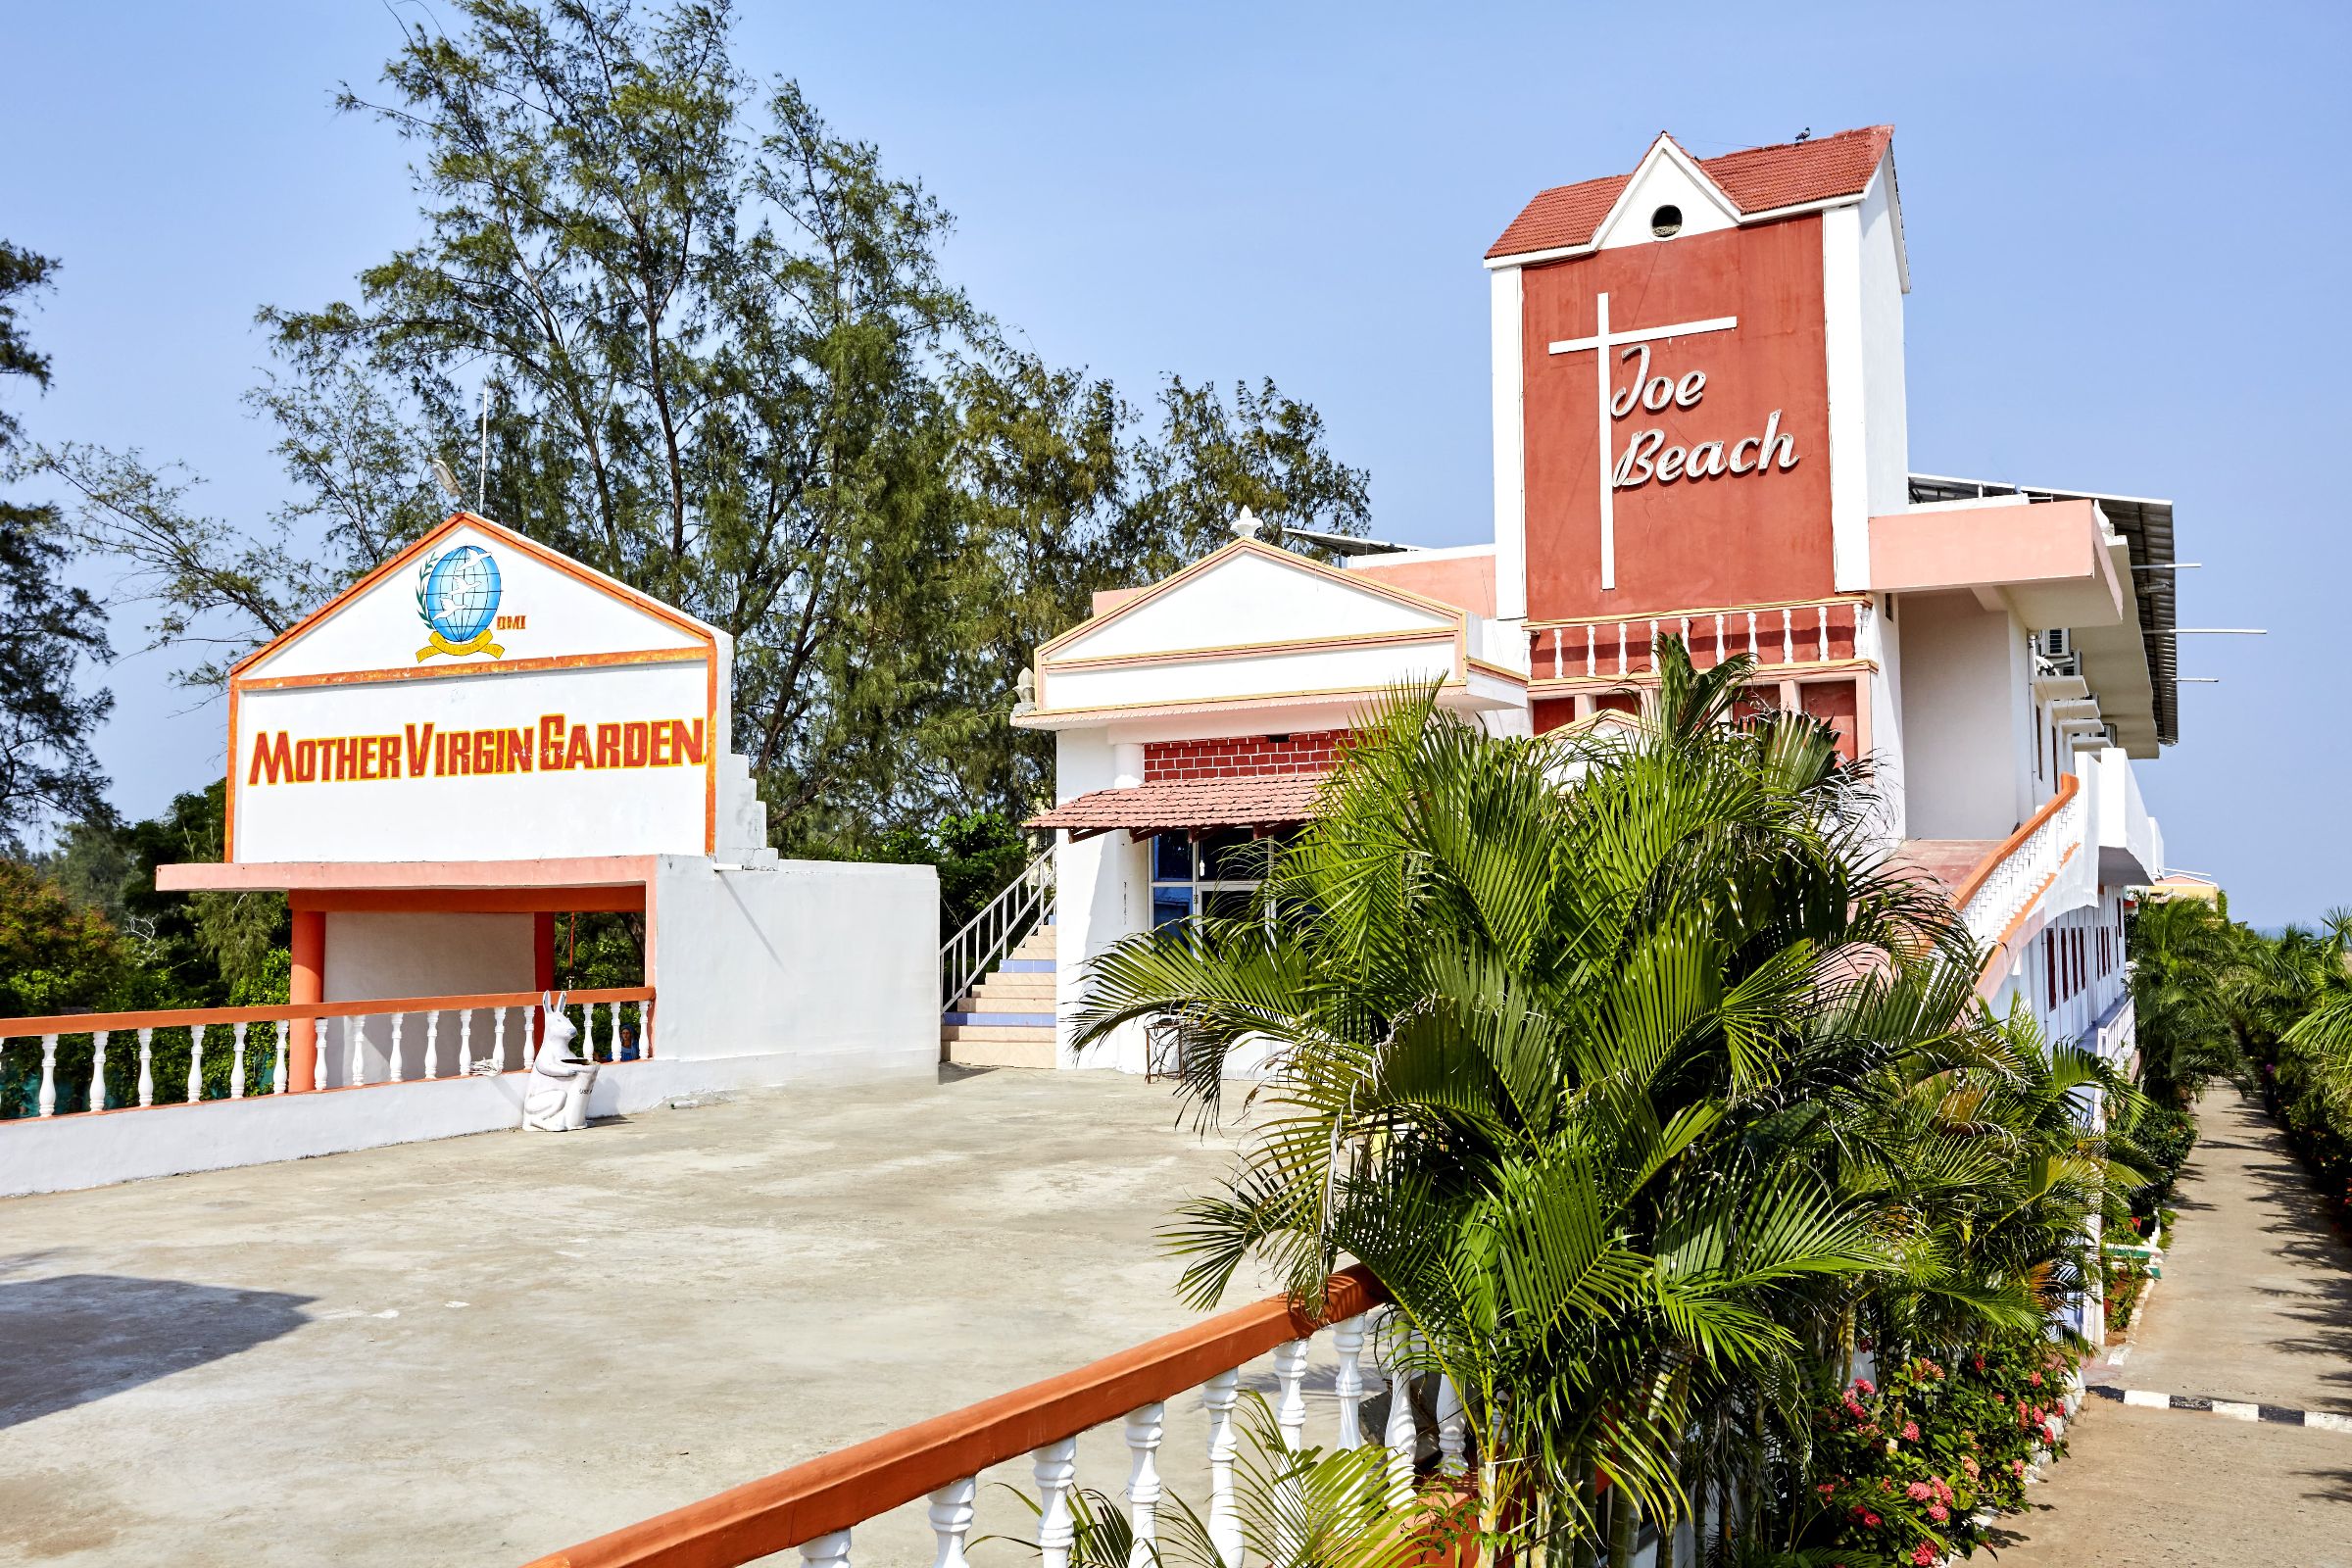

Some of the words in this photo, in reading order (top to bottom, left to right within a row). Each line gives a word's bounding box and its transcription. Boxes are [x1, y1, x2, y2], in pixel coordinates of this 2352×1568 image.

[1610, 344, 1707, 417] Joe
[1611, 409, 1800, 488] Beach
[248, 730, 402, 786] MOTHER
[405, 721, 535, 778] VIRGIN
[539, 713, 704, 772] GARDEN
